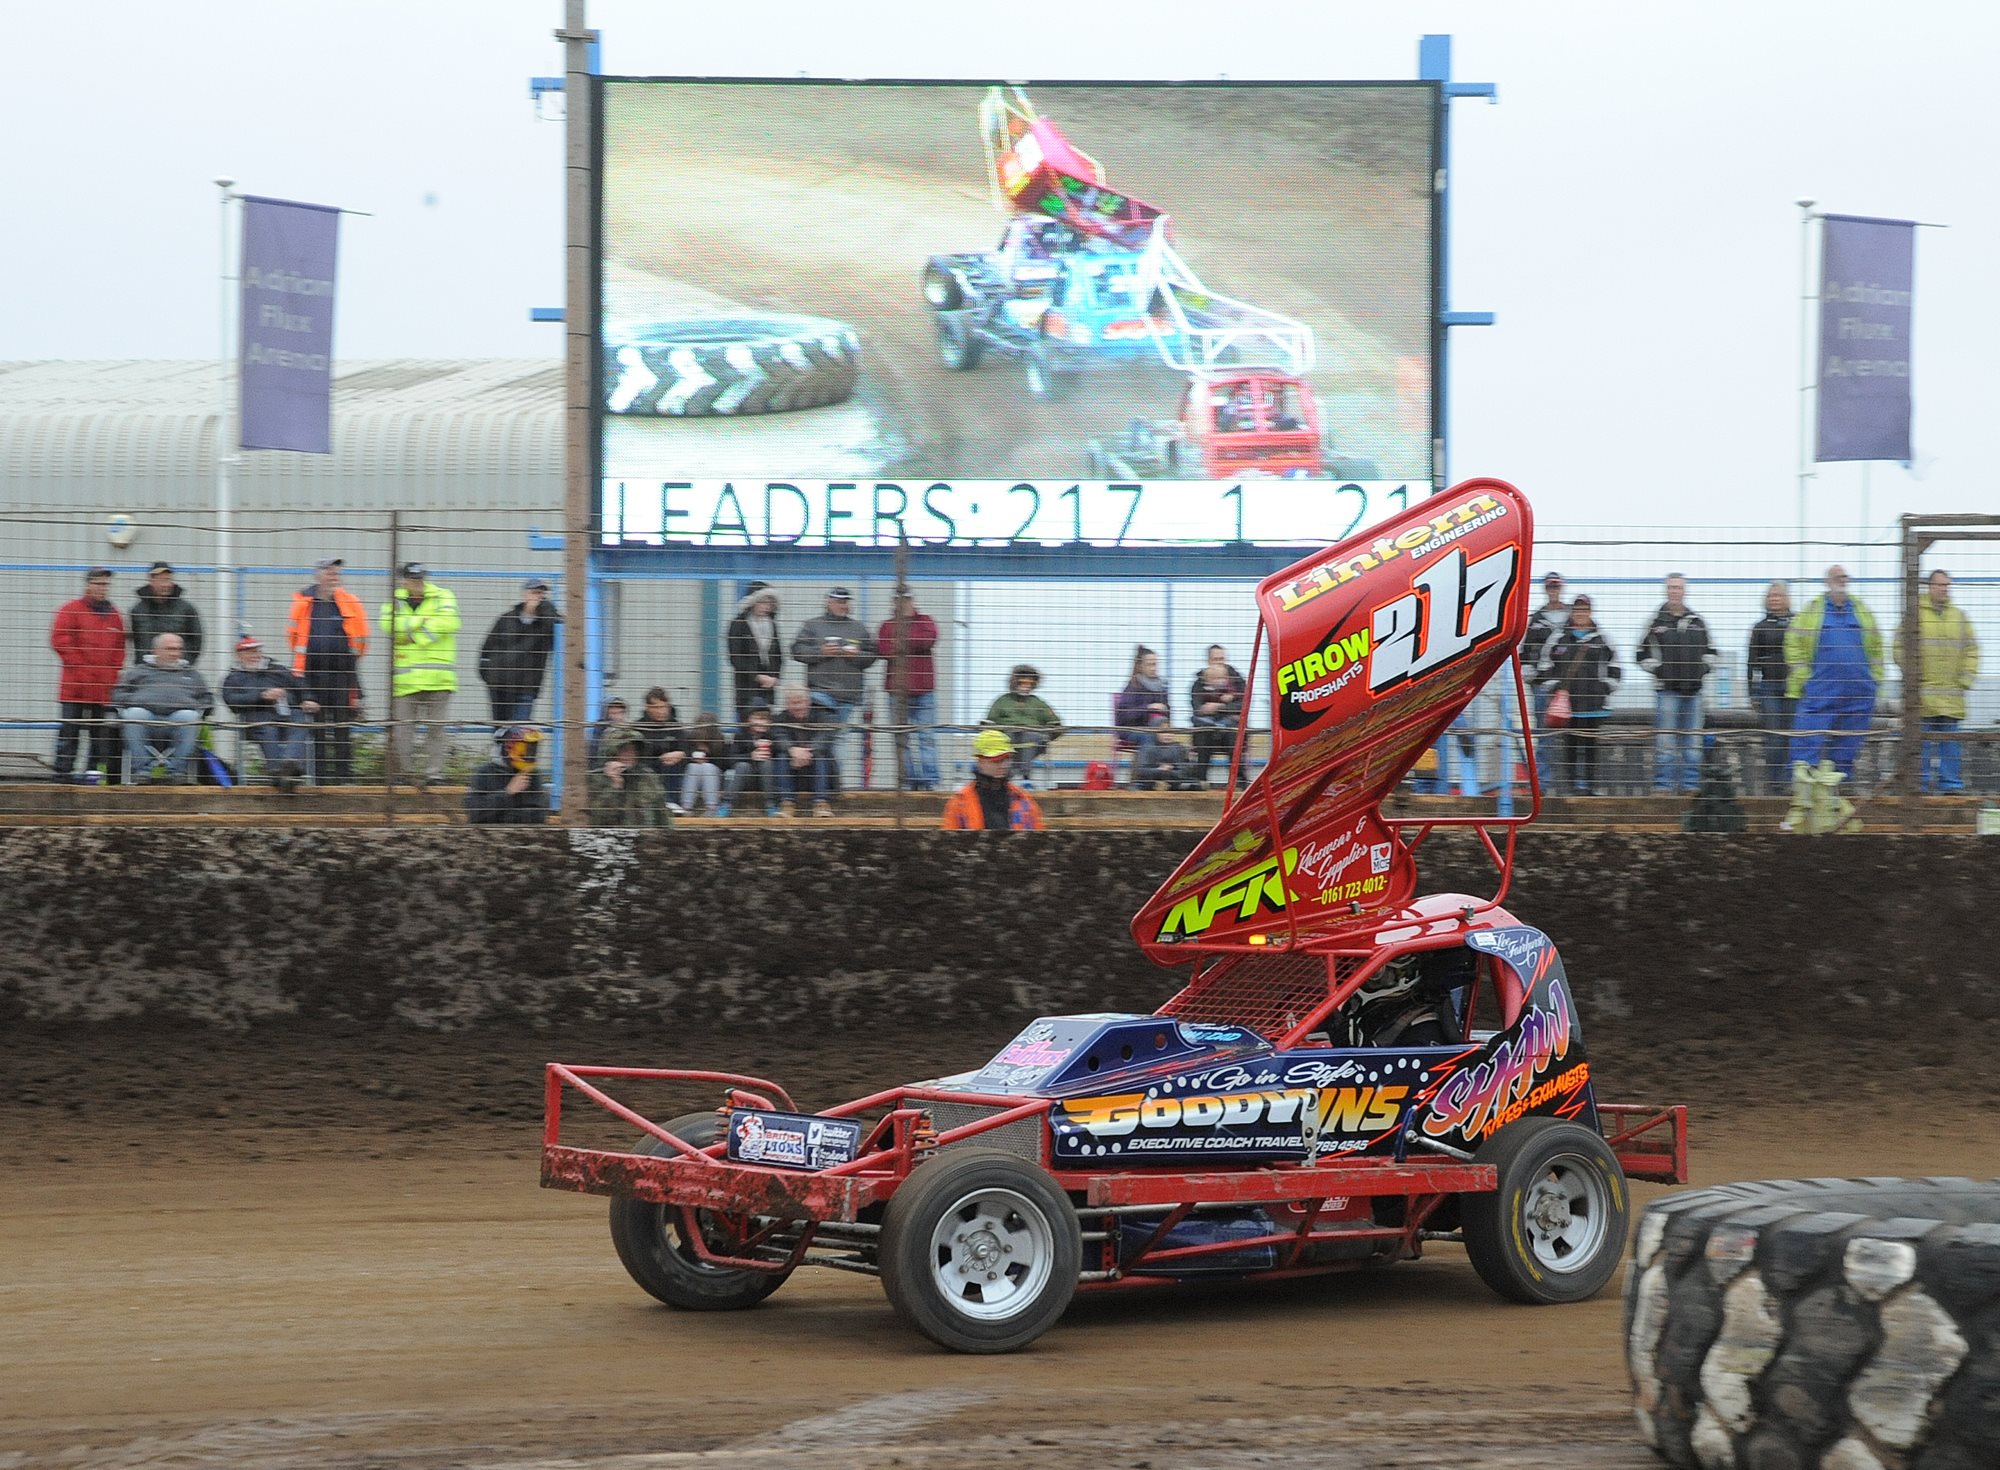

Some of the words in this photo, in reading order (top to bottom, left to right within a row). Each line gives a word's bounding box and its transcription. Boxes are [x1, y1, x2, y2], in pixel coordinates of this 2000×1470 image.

[619, 482, 978, 546] LEADERS:
[1009, 483, 1142, 547] 217
[1221, 484, 1254, 547] 1
[1411, 506, 1507, 560] ENGINEERING
[1274, 494, 1498, 612] Lintern
[1368, 543, 1520, 696] 217
[1277, 628, 1369, 696] FIROW
[1291, 662, 1364, 703] PROPSHAFTS
[1321, 885, 1343, 905] 0161
[1345, 881, 1361, 898] 723
[1362, 875, 1385, 893] 4012
[1254, 1069, 1281, 1085] in
[1422, 979, 1570, 1142] SHAW
[1530, 1062, 1589, 1108] EXHAUSTS
[1128, 1138, 1204, 1150] EXECUTIVE
[1204, 1137, 1253, 1149] COACH
[1255, 1136, 1303, 1148] TRAVEL
[1338, 1139, 1369, 1151] 4545
